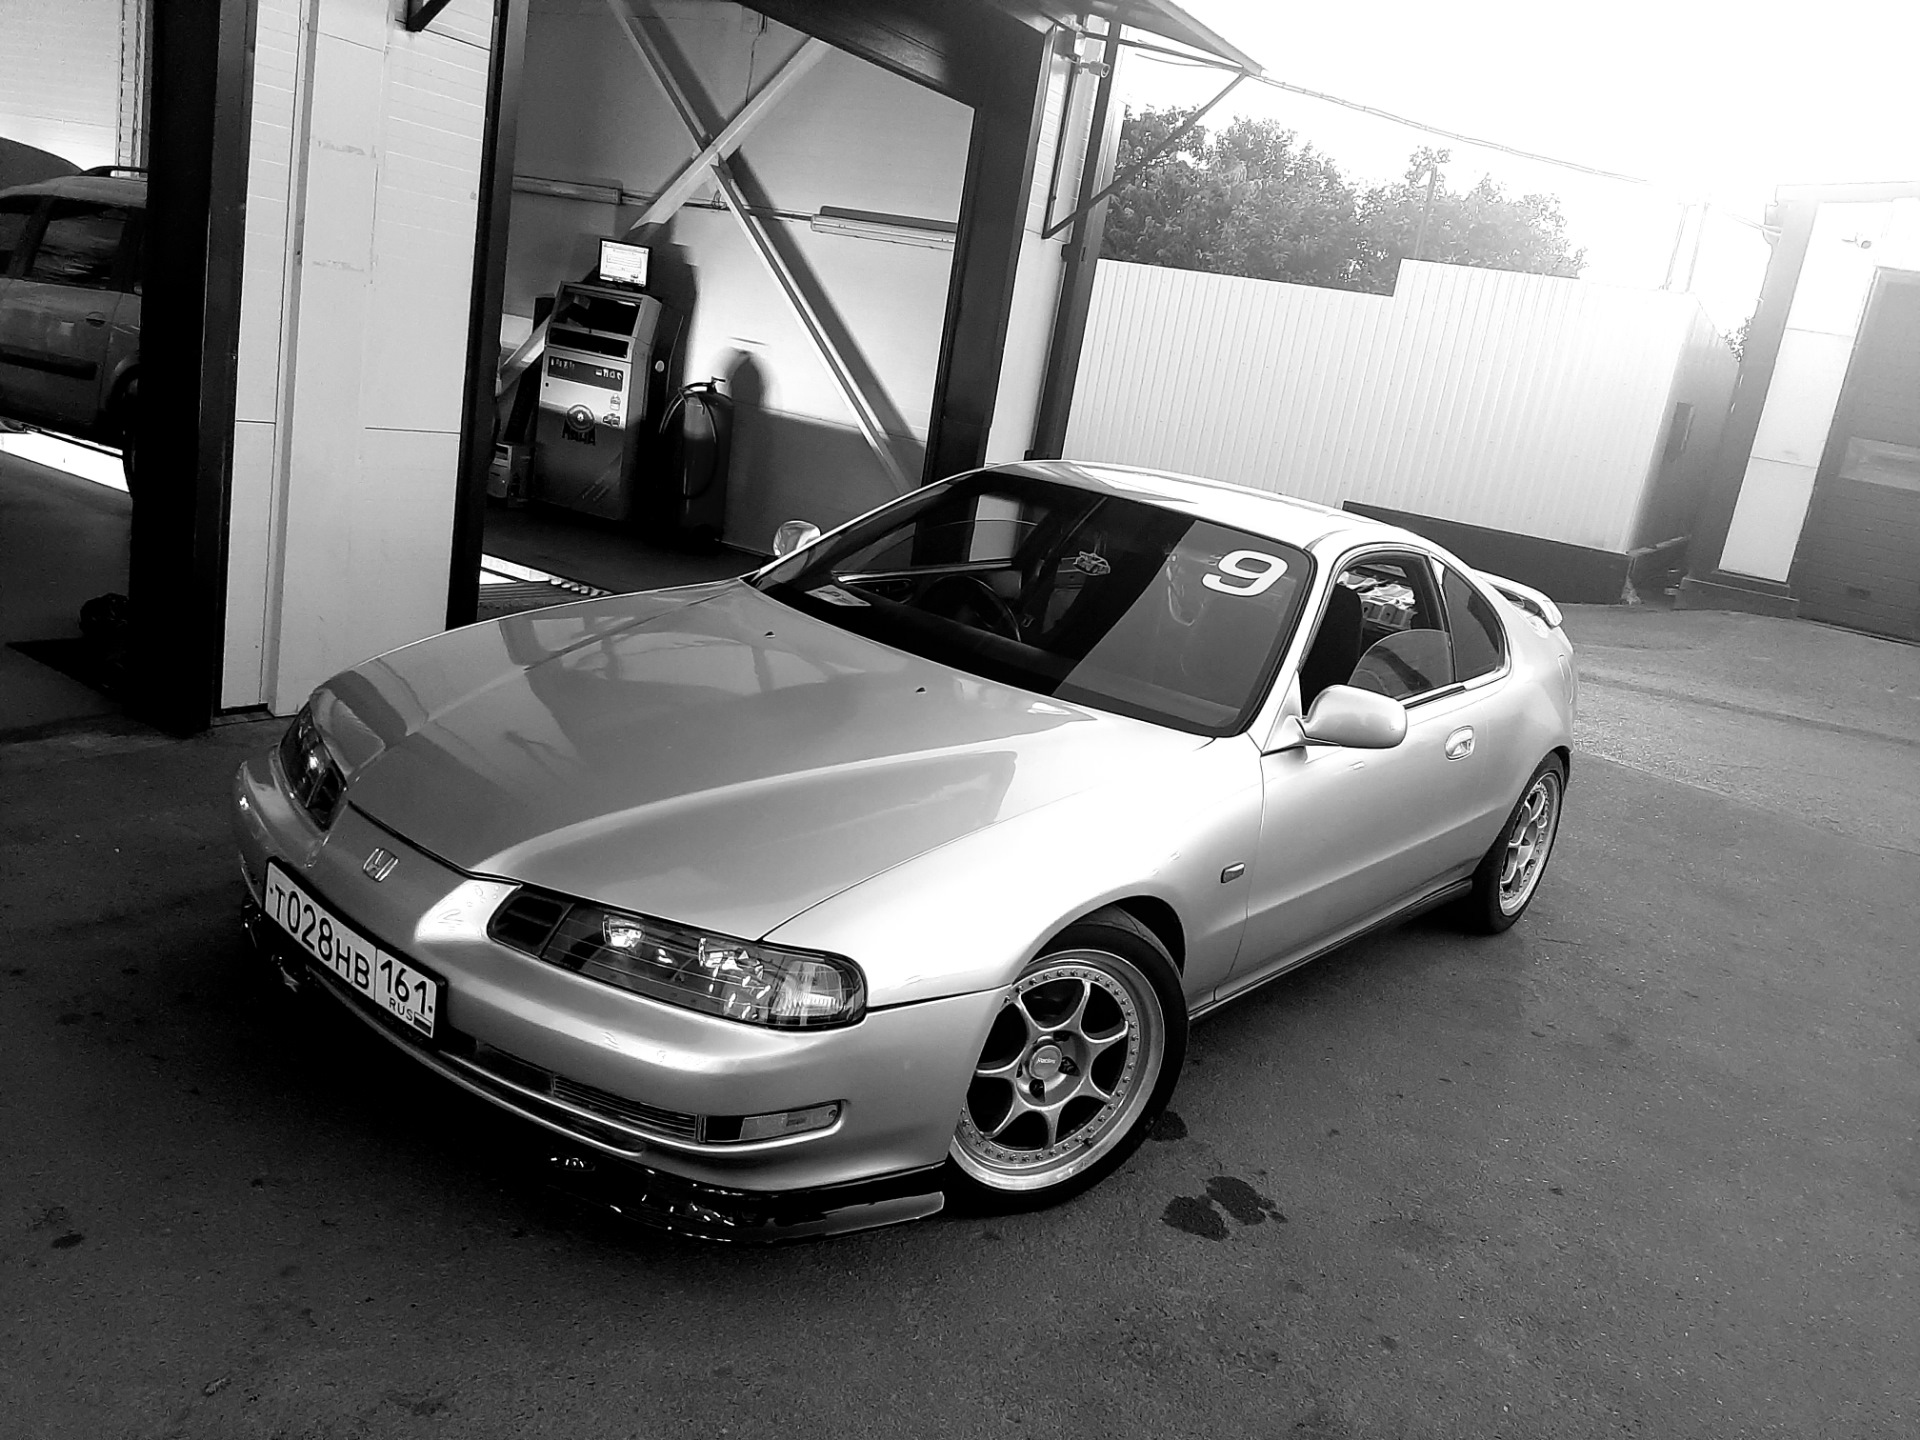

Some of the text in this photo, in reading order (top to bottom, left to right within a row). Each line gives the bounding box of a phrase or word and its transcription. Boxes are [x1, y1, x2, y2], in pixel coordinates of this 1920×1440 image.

[1202, 550, 1288, 597] 9
[380, 959, 428, 1015] 161
[389, 997, 413, 1021] RUS
